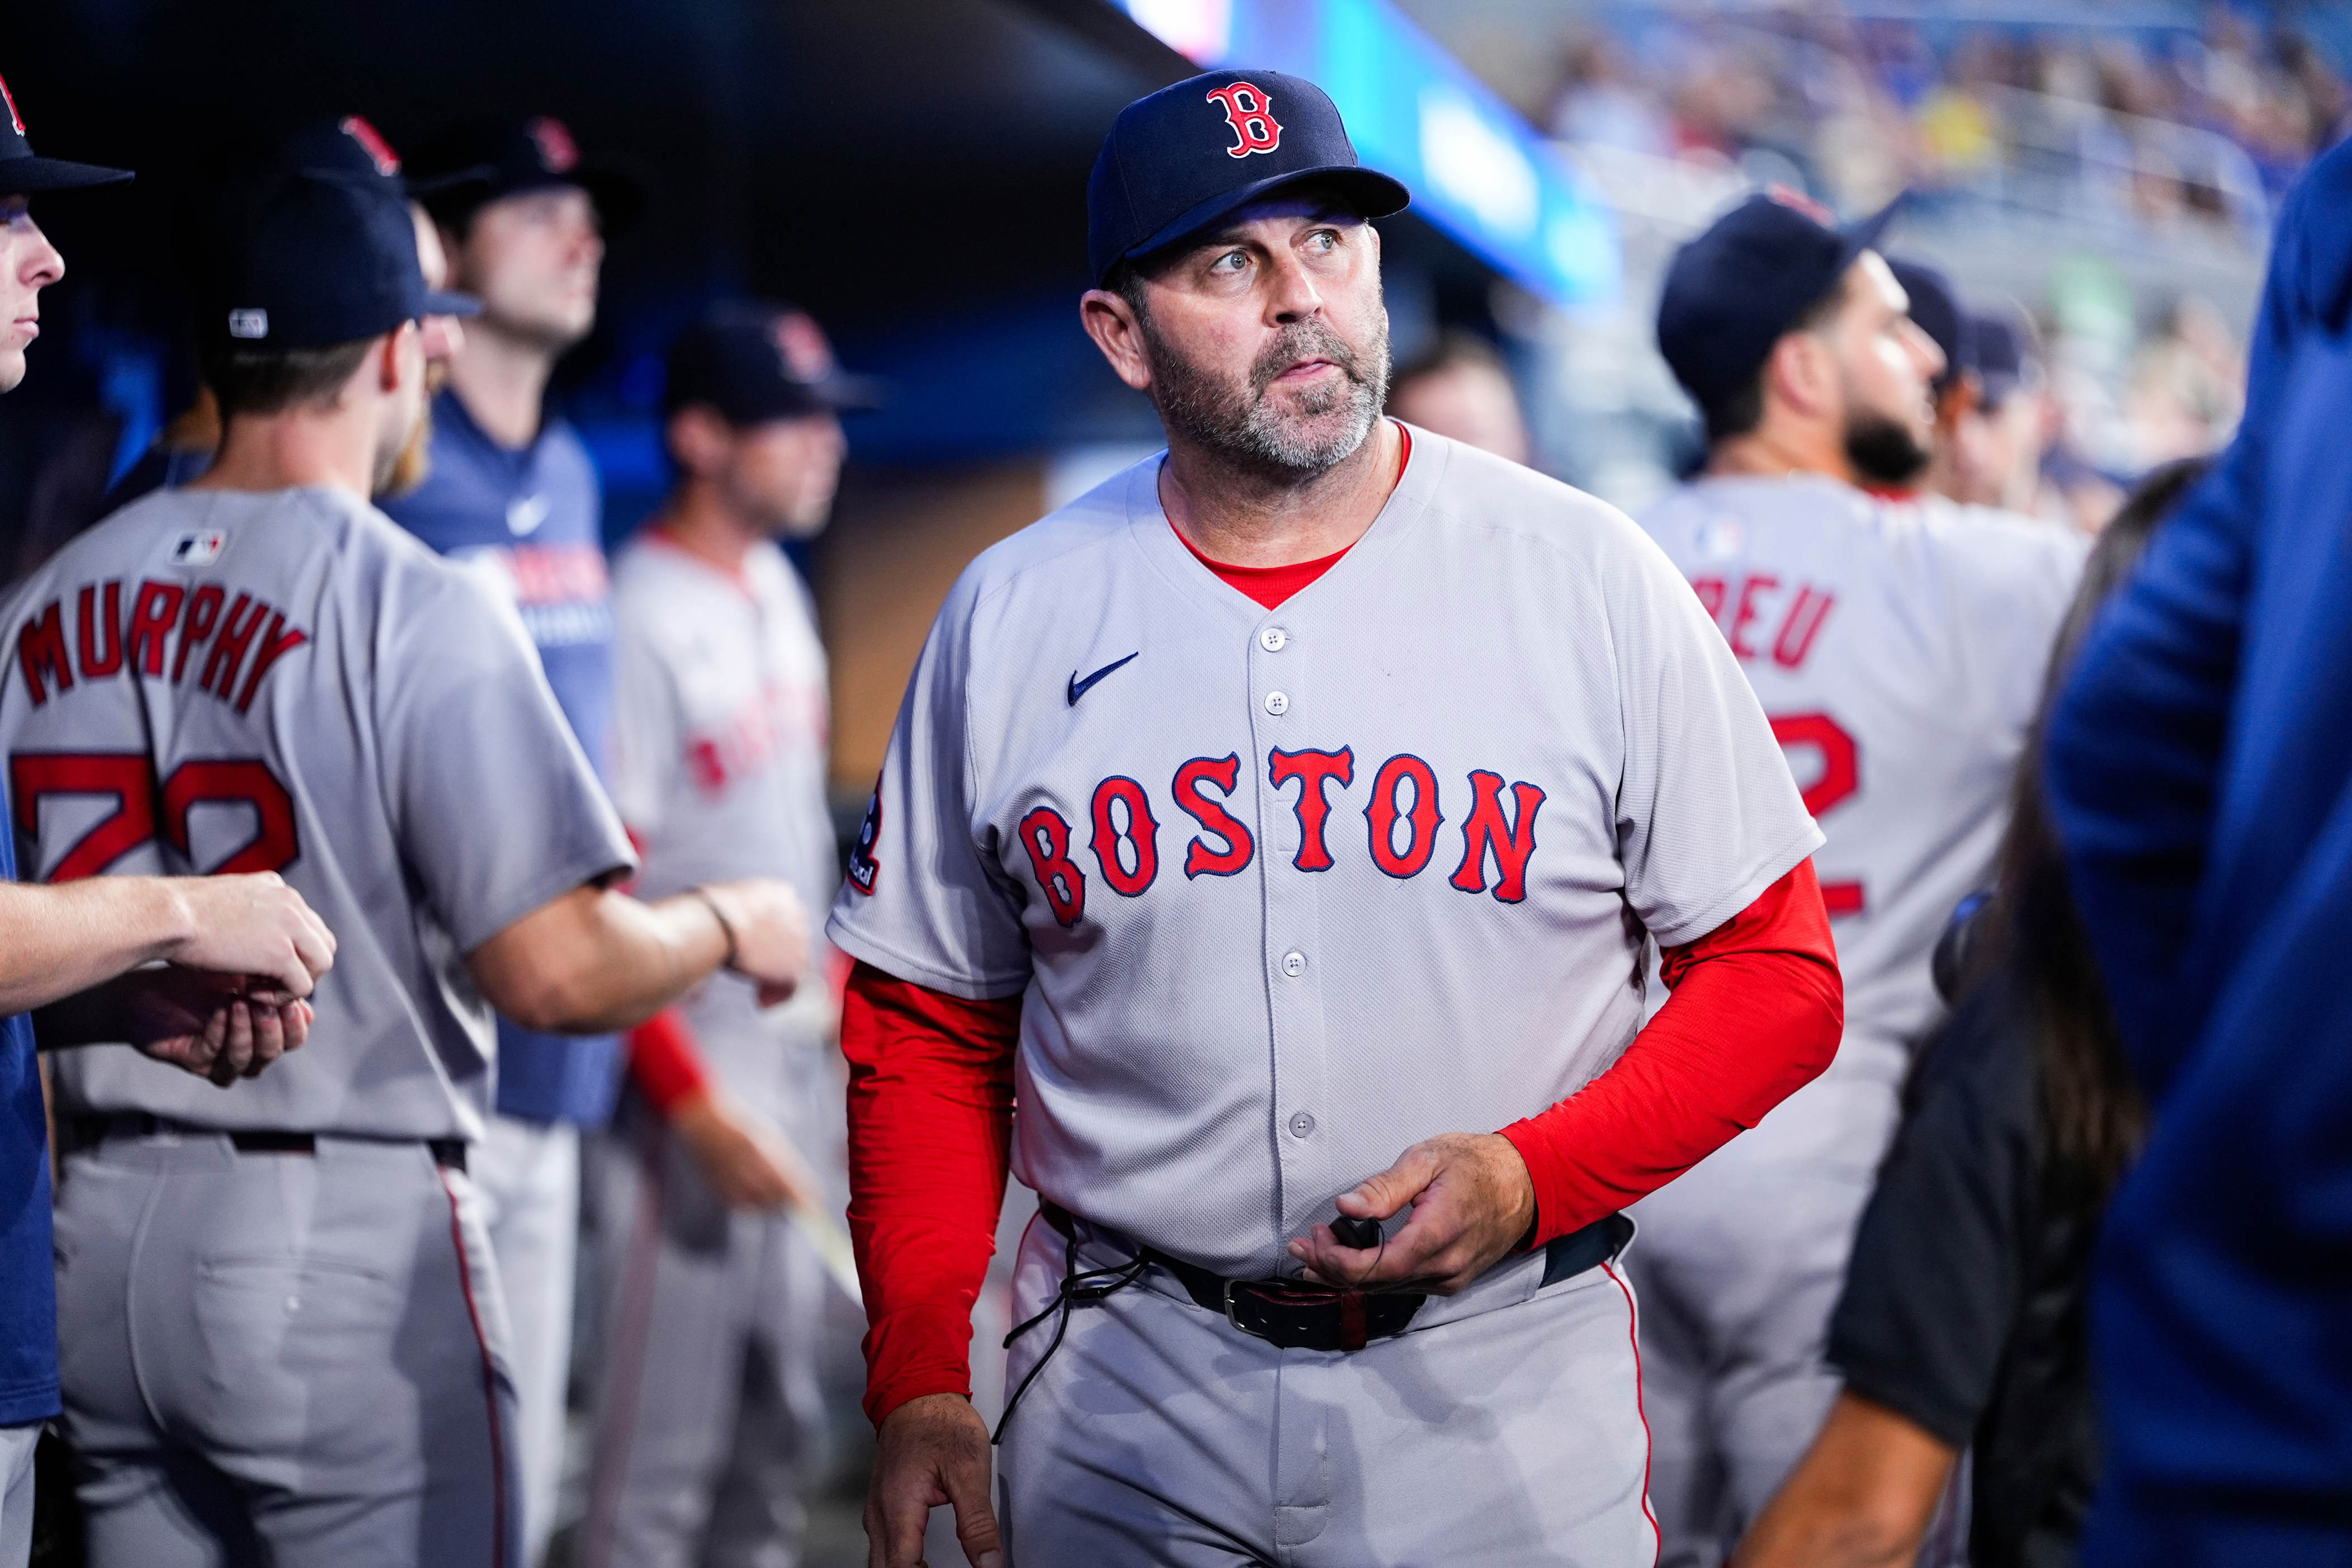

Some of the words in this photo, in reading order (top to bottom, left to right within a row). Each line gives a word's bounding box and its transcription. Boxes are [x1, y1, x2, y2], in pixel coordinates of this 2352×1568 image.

[1206, 81, 1284, 159] B
[18, 580, 308, 715] MURPHY
[10, 752, 301, 885] 72
[1018, 744, 1547, 928] BOSTON
